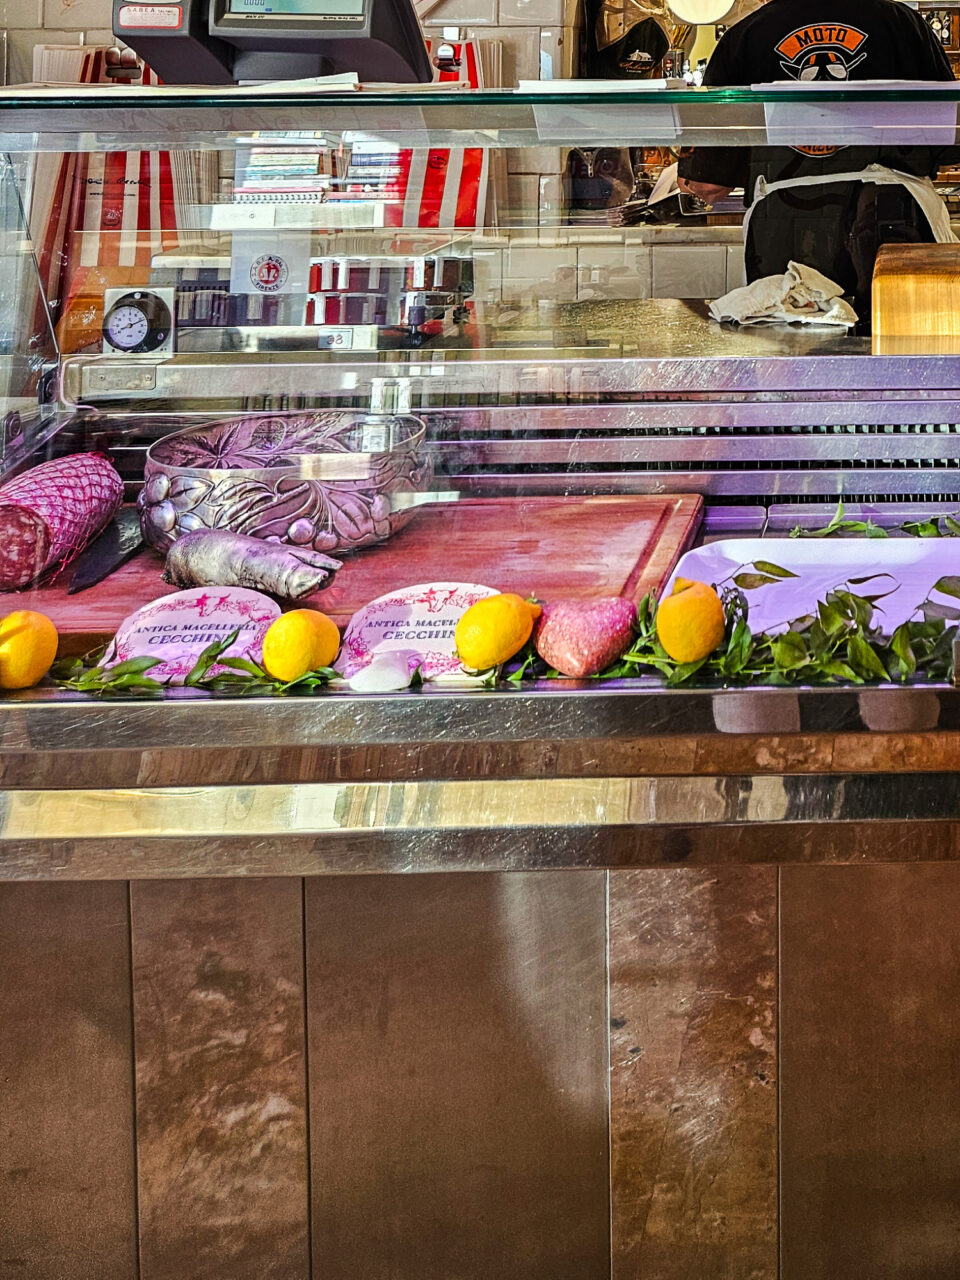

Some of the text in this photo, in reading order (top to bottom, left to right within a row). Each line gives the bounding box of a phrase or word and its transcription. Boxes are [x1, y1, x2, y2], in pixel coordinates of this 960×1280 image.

[794, 27, 848, 48] MOTO
[134, 623, 178, 634] ANTICA
[365, 619, 411, 629] ANTICA
[147, 632, 230, 645] CECCHIN
[382, 629, 456, 640] CECCHIN
